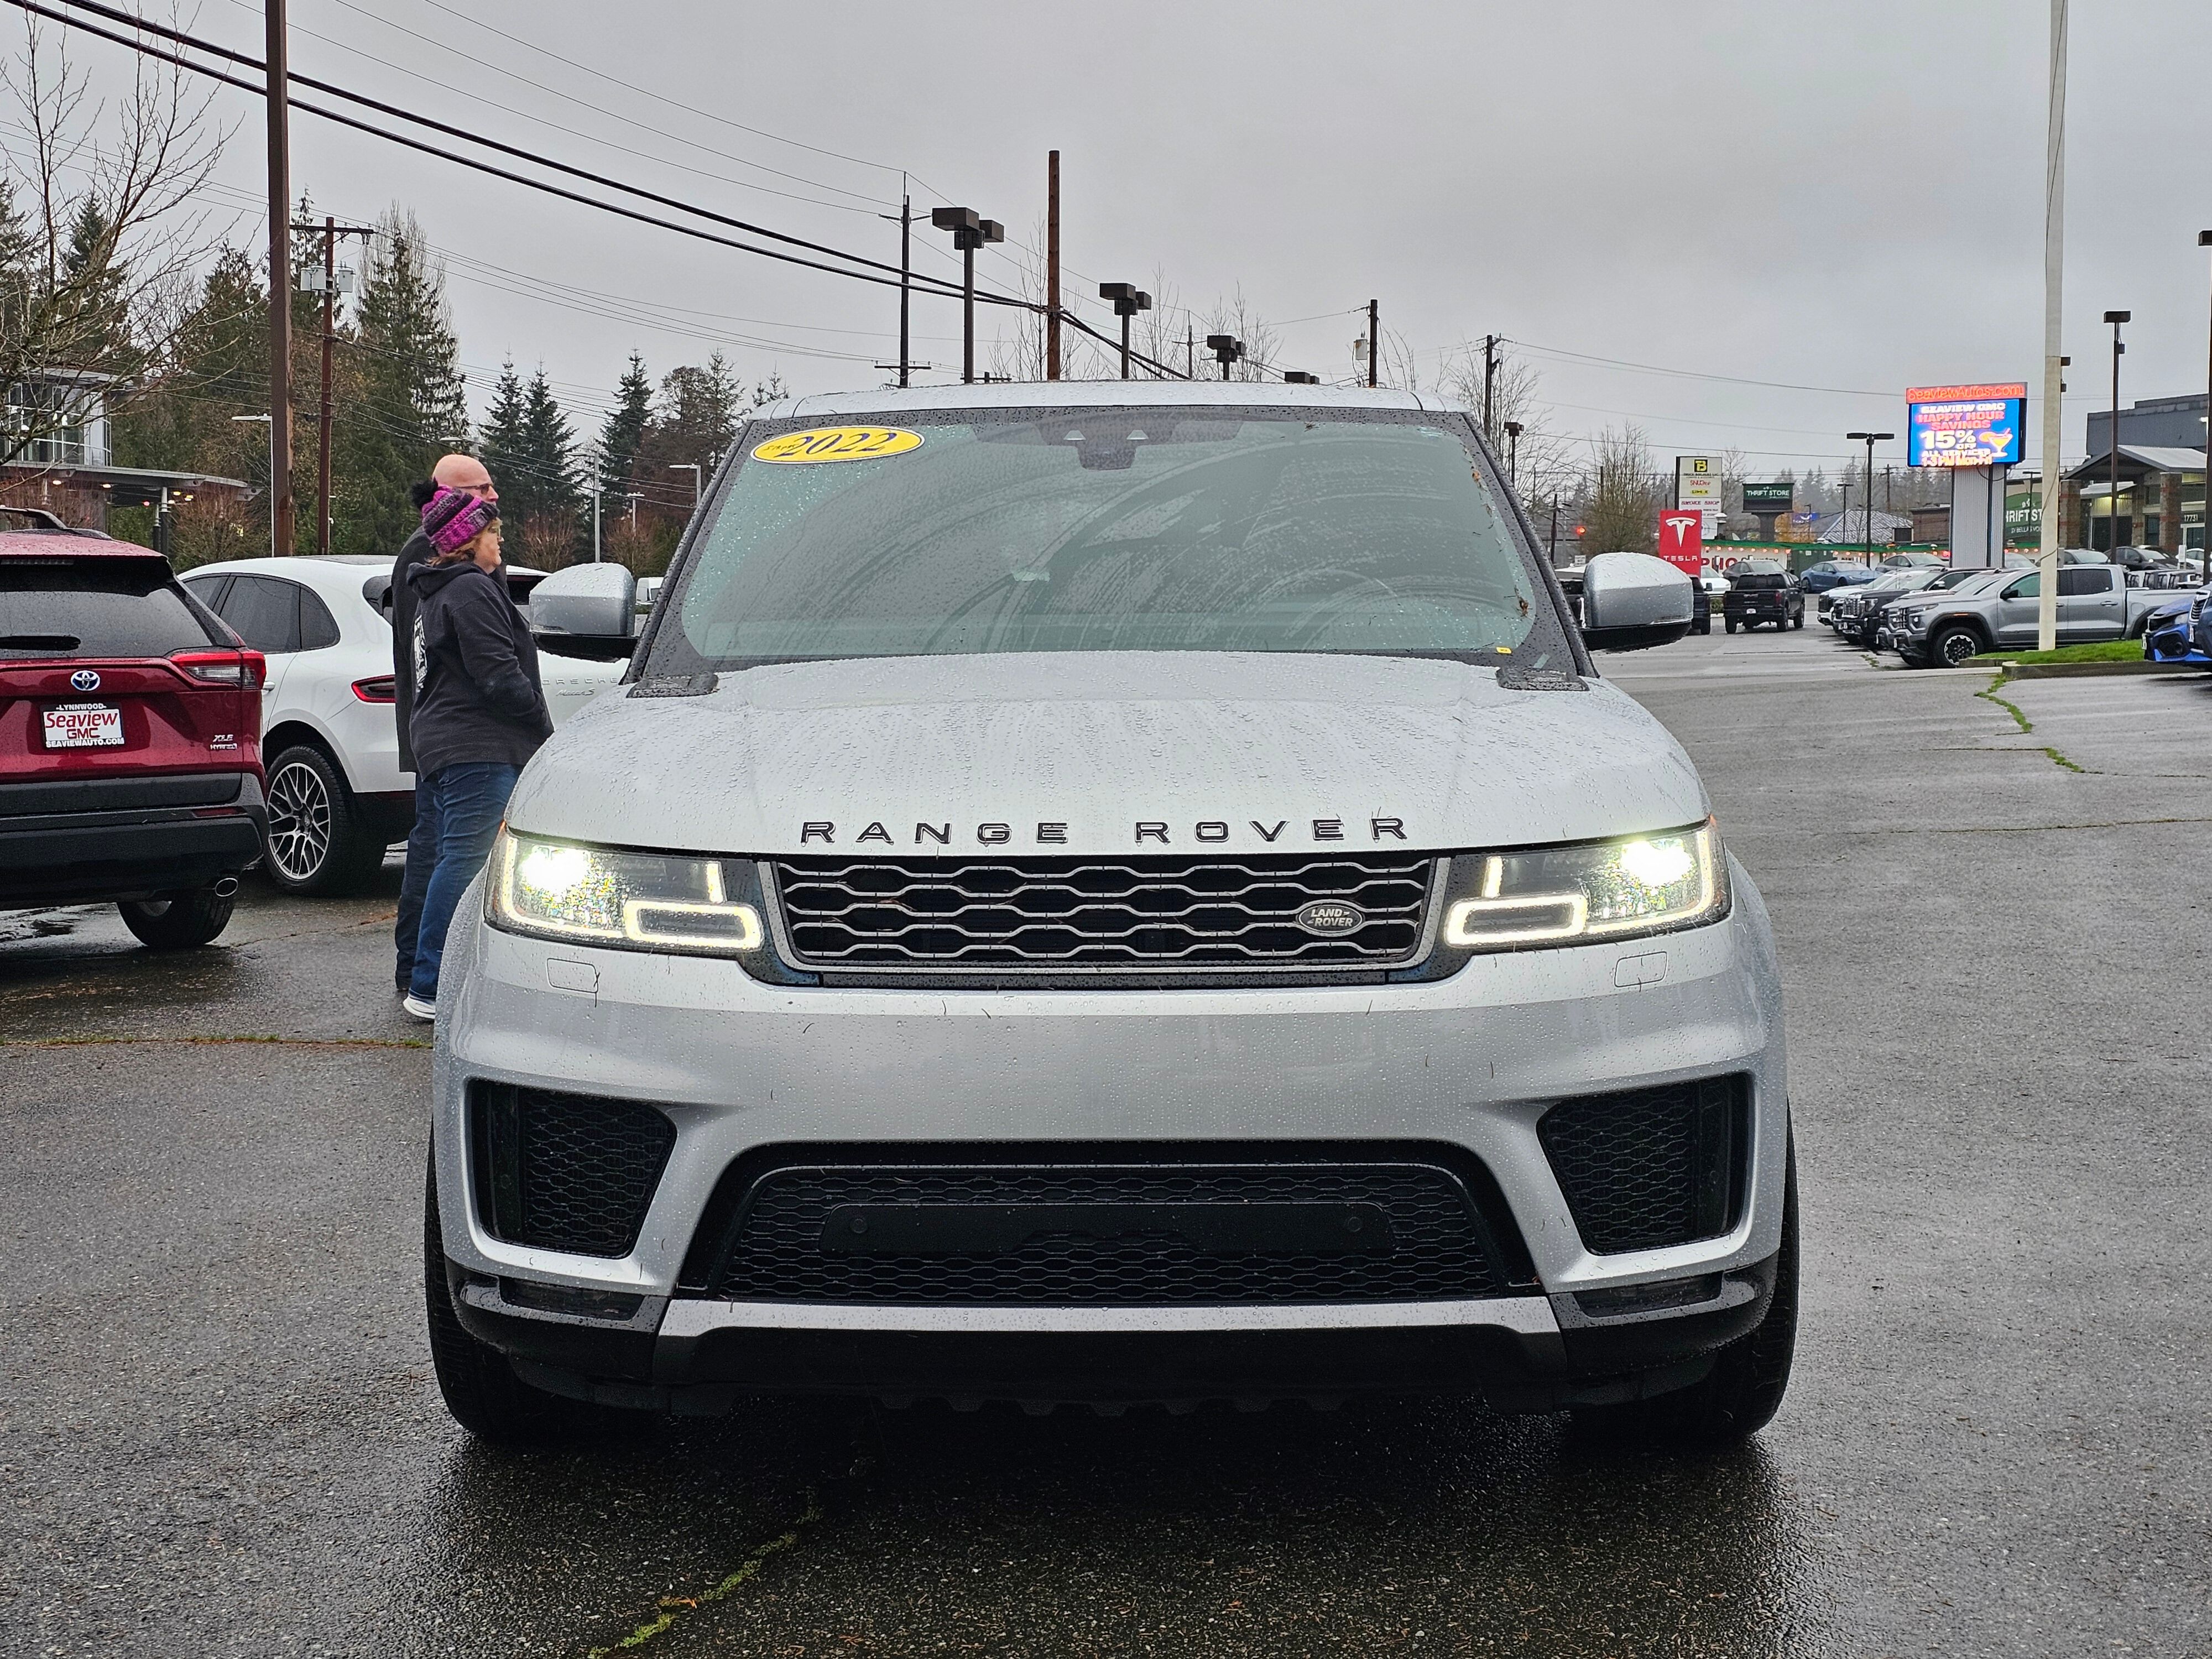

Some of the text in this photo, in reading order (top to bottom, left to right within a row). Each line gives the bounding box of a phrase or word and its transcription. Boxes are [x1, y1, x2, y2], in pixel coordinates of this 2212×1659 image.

[1921, 402, 2006, 414] SEAVIEW GMC
[1918, 411, 2005, 423] HAPPY HOUR
[1931, 420, 1991, 430] SAVINGS
[773, 432, 897, 457] 2022
[1920, 429, 1976, 450] 15%
[45, 711, 118, 728] Seaview
[66, 727, 101, 740] GMC
[46, 737, 125, 748] SEAVIEWAUTO.COM
[801, 817, 1407, 844] RANGE ROVER
